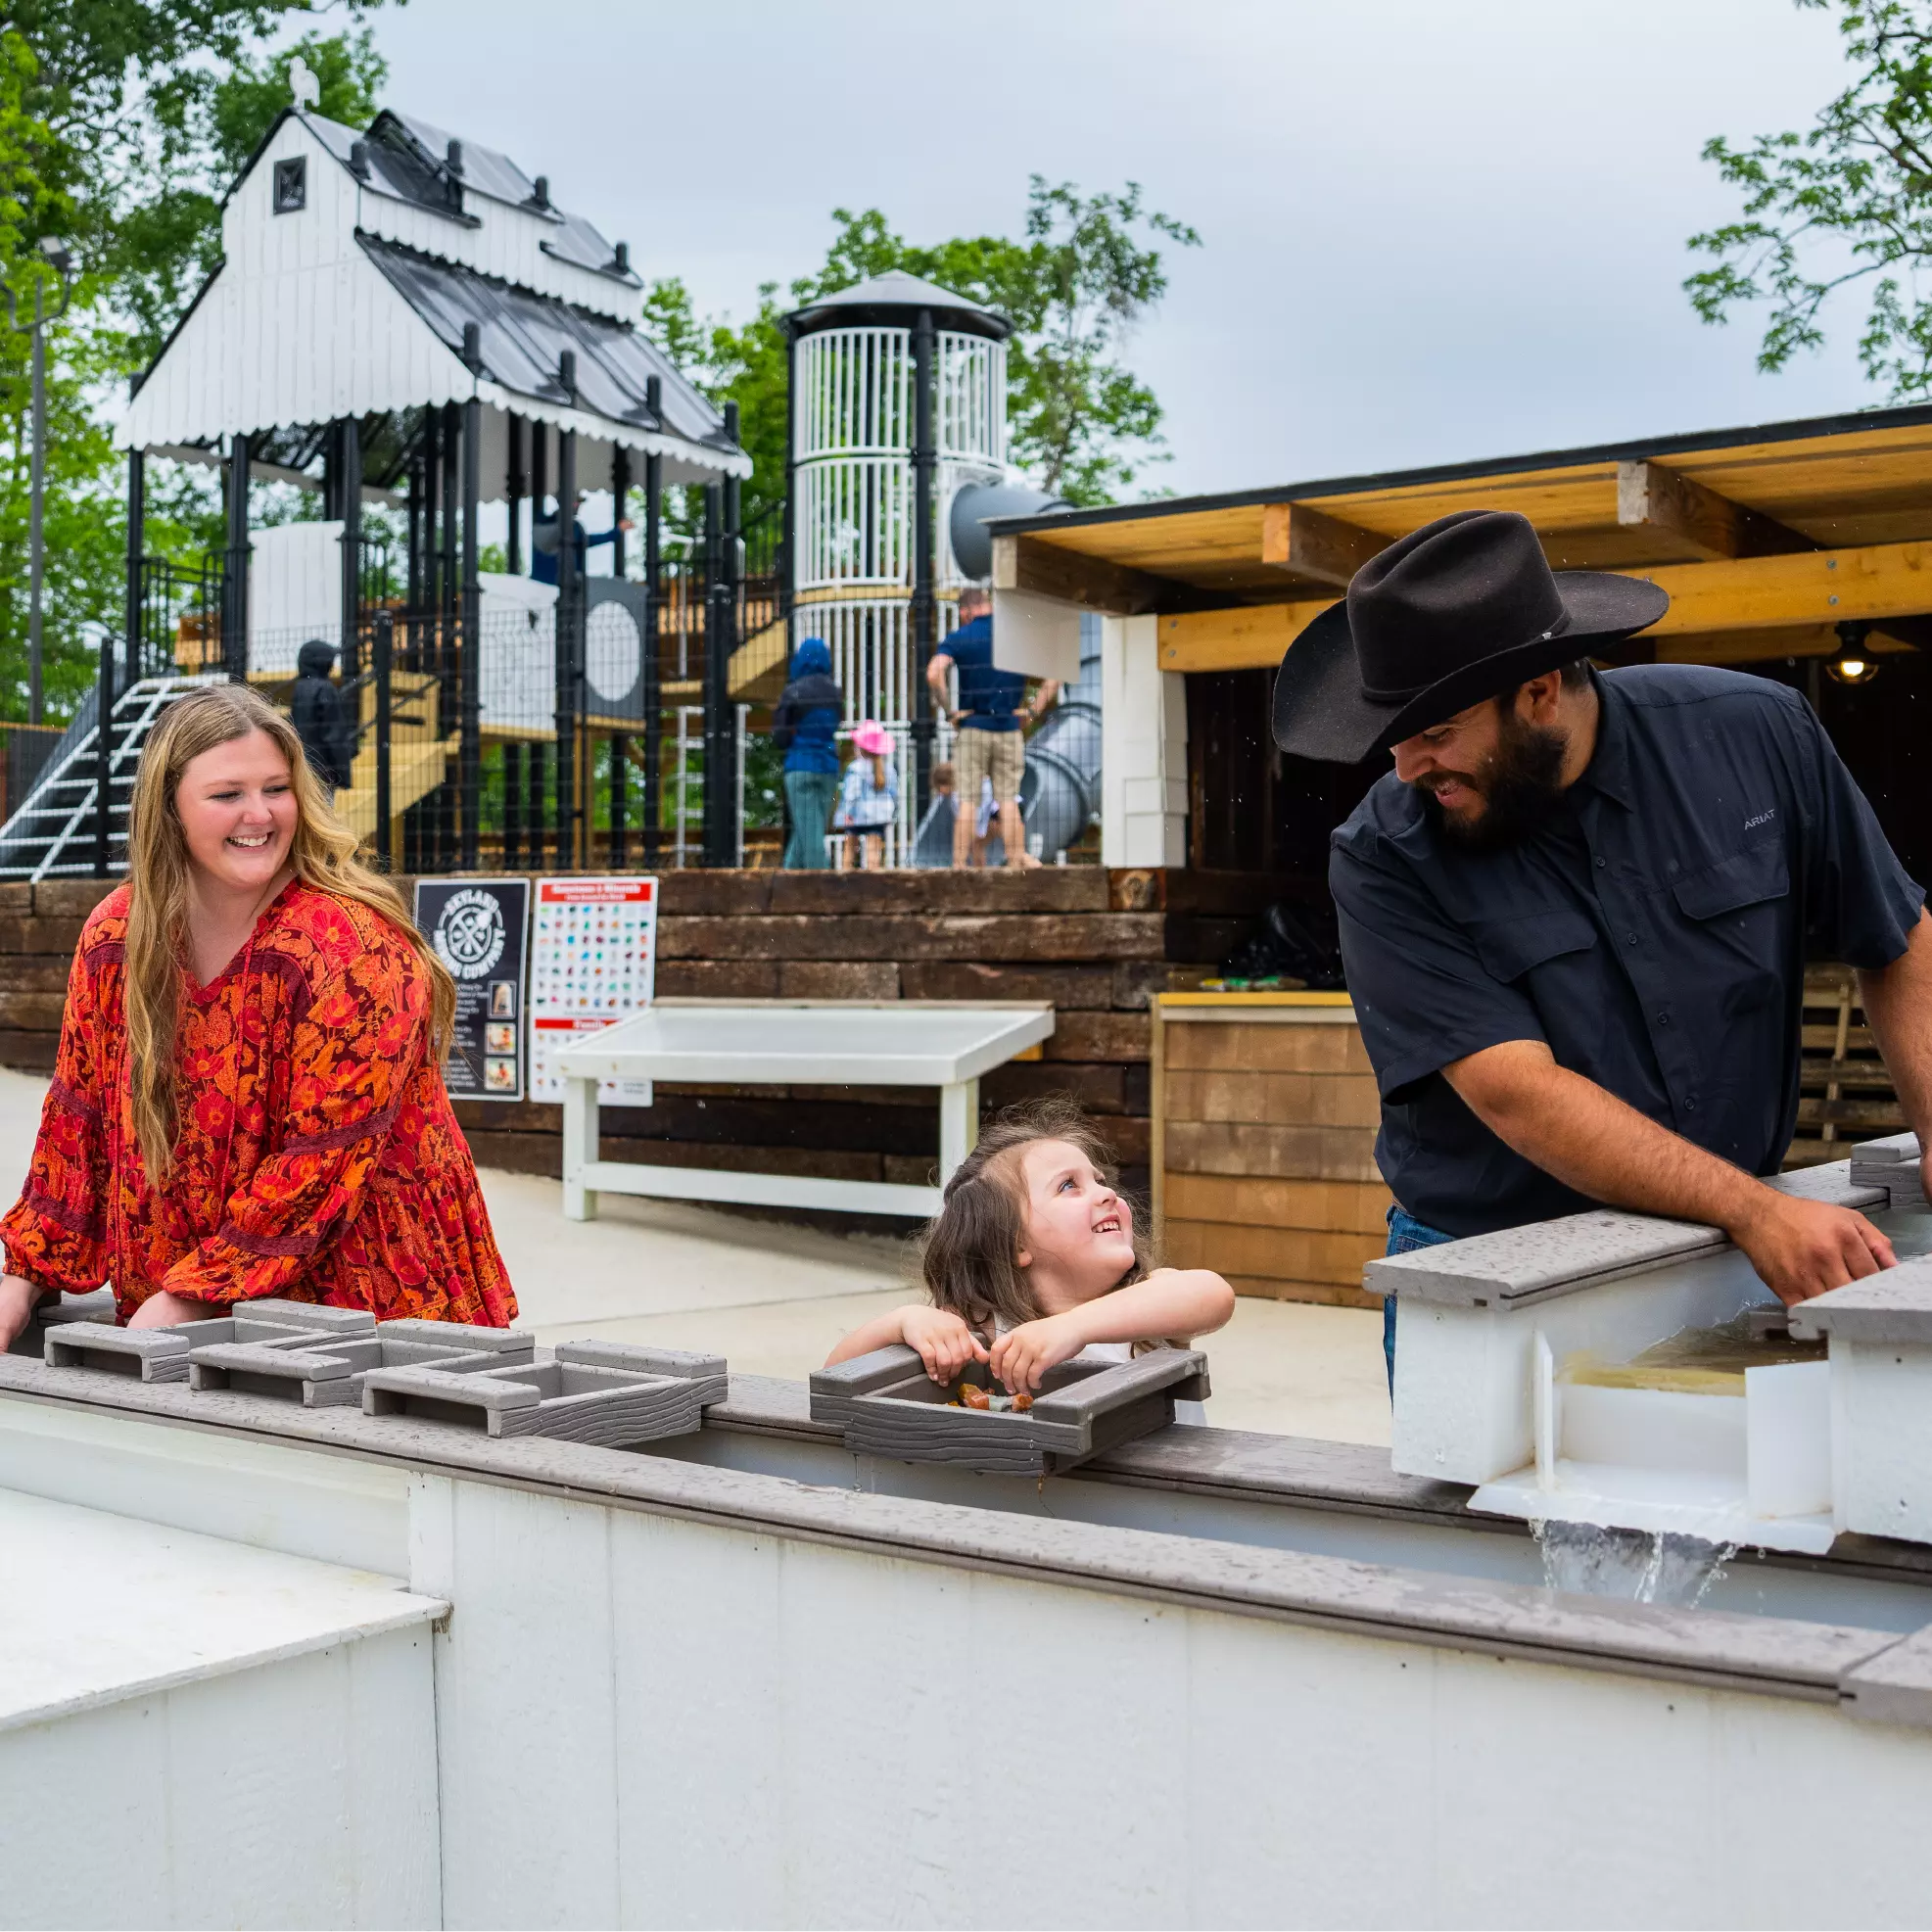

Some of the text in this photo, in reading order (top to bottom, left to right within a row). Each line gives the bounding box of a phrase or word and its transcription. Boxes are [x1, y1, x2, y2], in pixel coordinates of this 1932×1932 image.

[1744, 808, 1775, 830] ARIAT
[444, 888, 500, 917] SKYLAND
[461, 927, 506, 980] COMPANY
